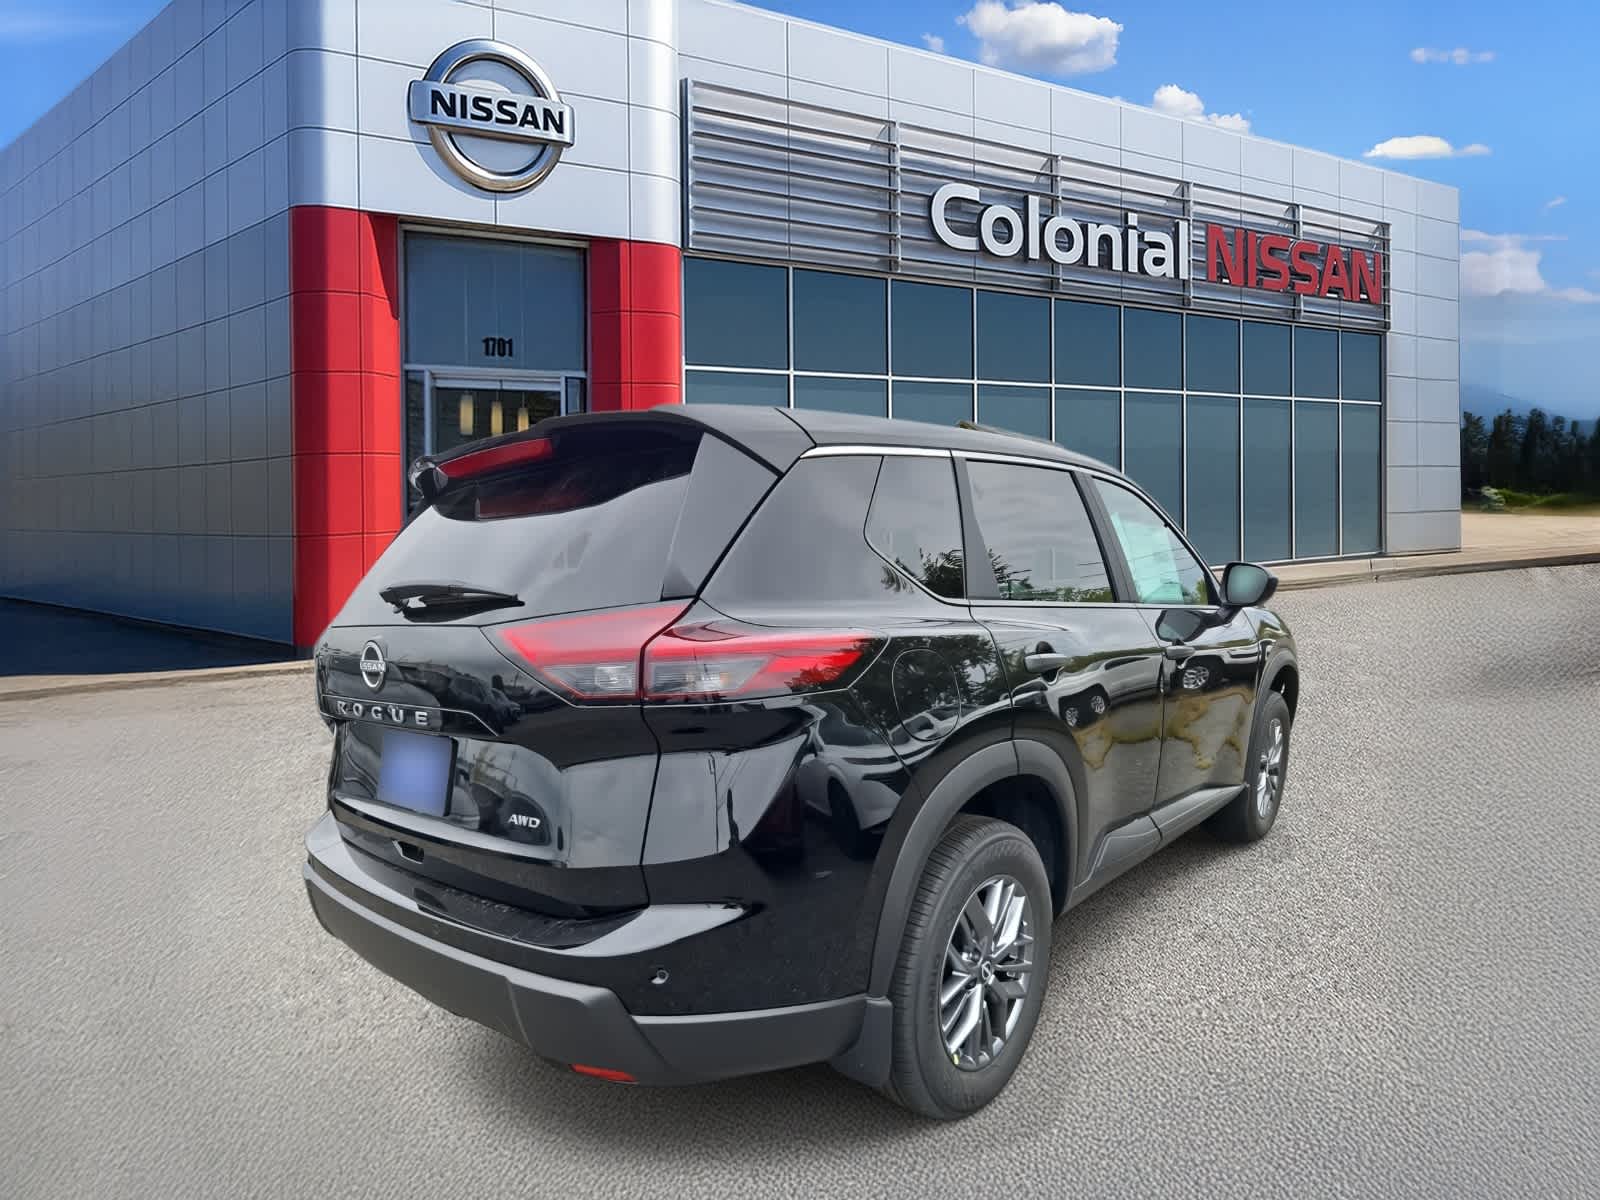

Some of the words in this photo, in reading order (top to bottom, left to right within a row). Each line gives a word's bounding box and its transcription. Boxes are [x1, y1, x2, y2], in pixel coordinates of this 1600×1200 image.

[430, 89, 564, 134] NISSAN
[931, 183, 1189, 280] Colonial
[1206, 223, 1382, 304] NISSAN
[482, 337, 513, 357] 1701
[360, 661, 385, 672] SSAN
[336, 700, 429, 726] ROGUE
[507, 813, 541, 828] AWD
